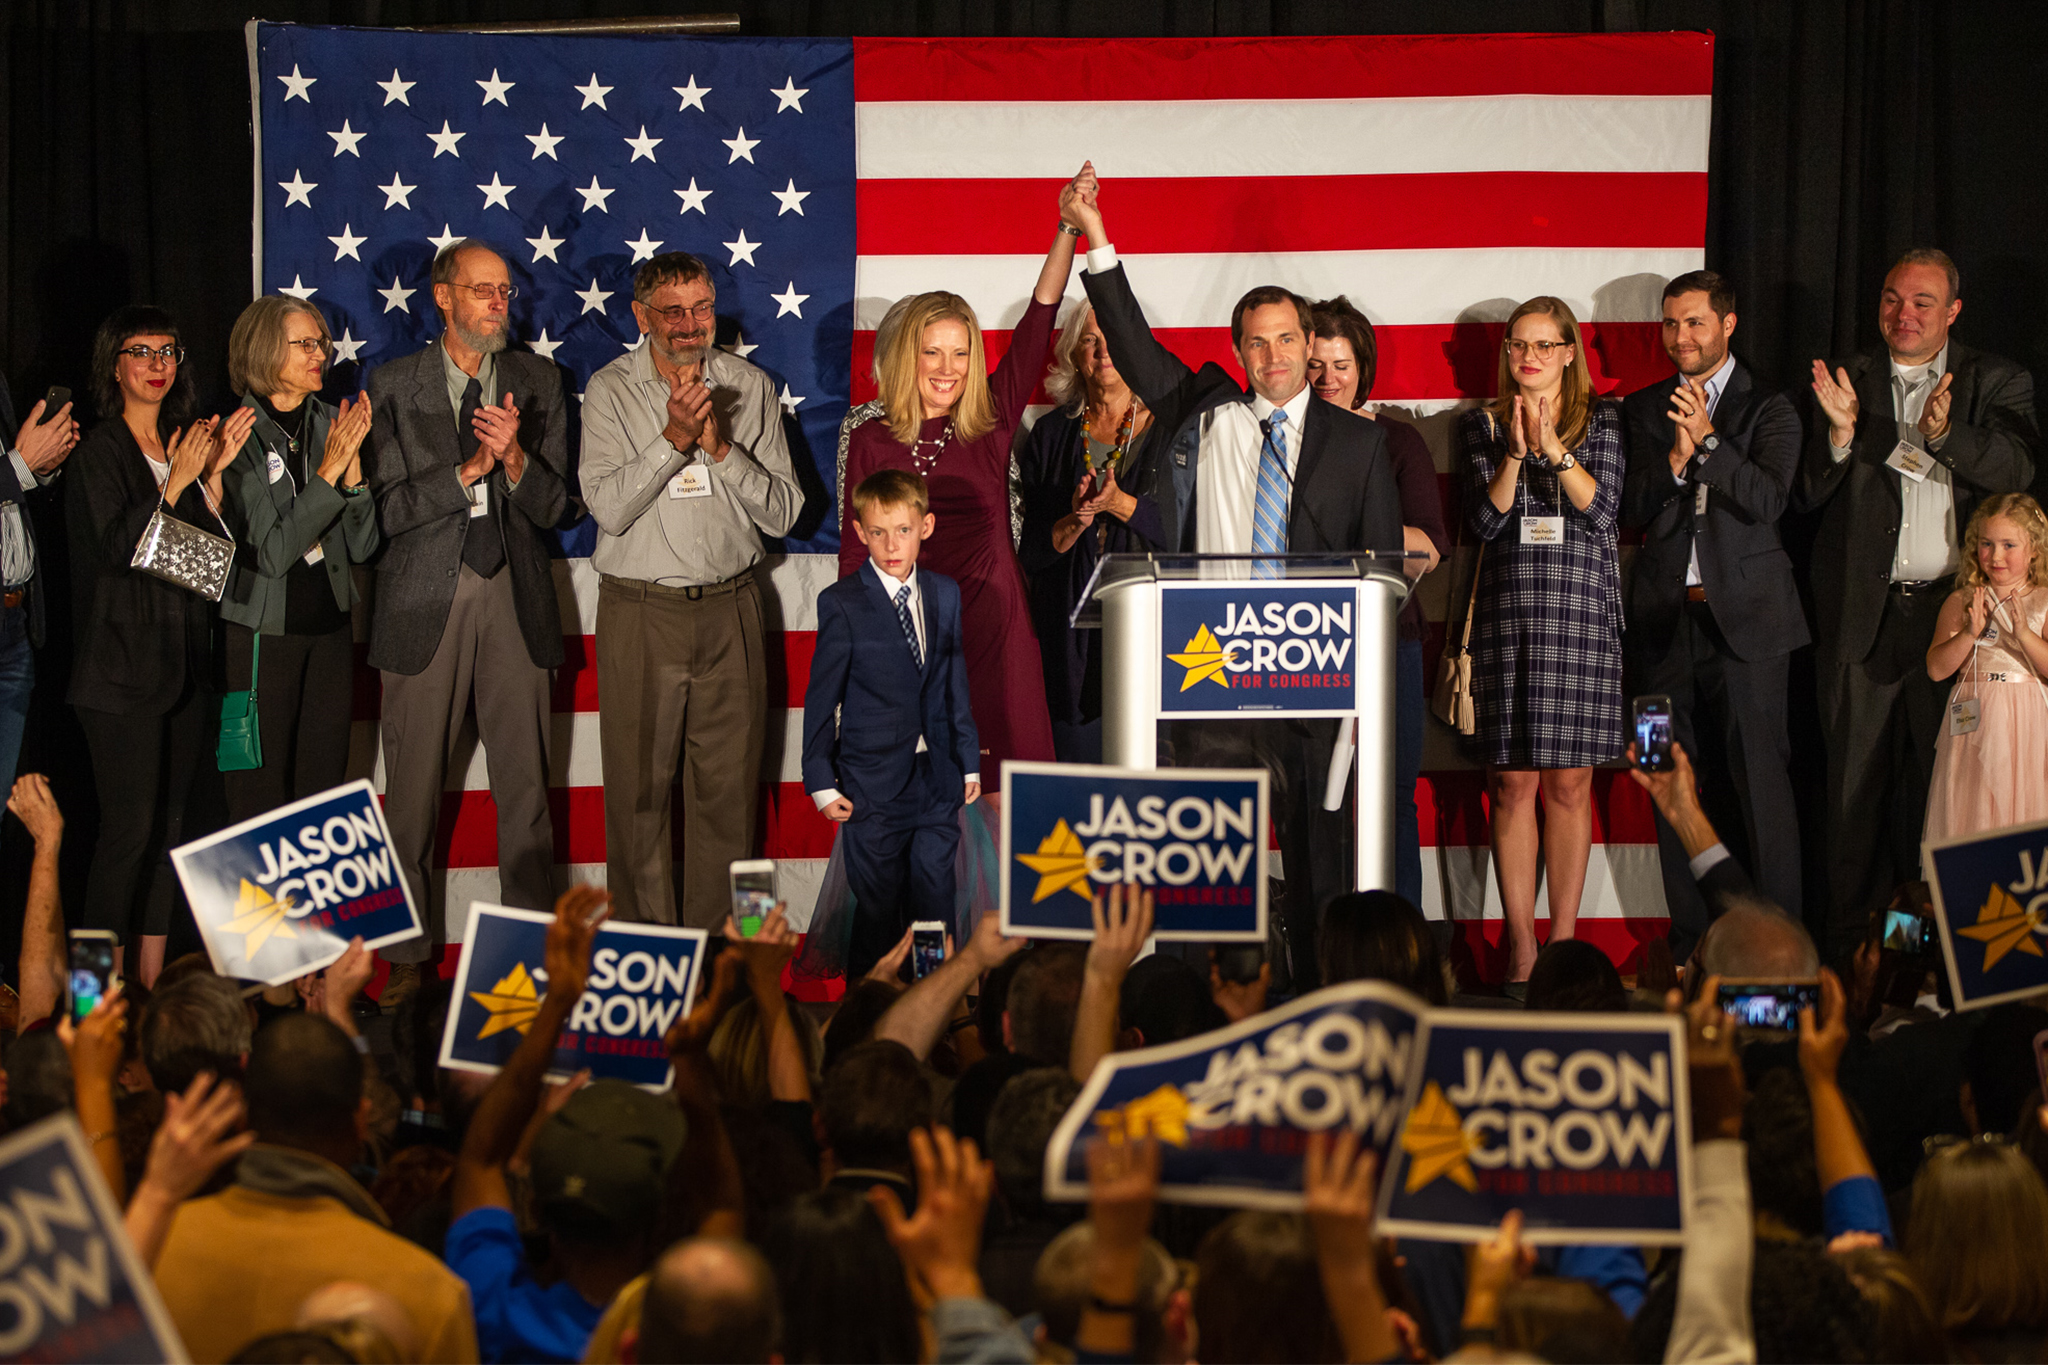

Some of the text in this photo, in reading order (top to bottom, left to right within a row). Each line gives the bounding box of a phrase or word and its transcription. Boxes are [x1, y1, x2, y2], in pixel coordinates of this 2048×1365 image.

[1900, 463, 1915, 473] Crow
[1901, 454, 1923, 469] Stephen
[677, 485, 706, 493] Fitzgerald
[1213, 602, 1351, 636] JASON
[1222, 638, 1352, 673] CROW
[1232, 673, 1351, 689] FOR CONGRESS
[1074, 793, 1254, 841] JASON
[256, 805, 384, 885] JASON
[1084, 839, 1255, 886] CROW
[276, 847, 392, 919] CROW
[532, 947, 691, 995] SON
[537, 991, 682, 1039] ROW
[1183, 1013, 1412, 1101] JASON
[1446, 1047, 1672, 1110] JASON
[1188, 1068, 1403, 1147] CROW
[1461, 1108, 1673, 1170] CROW
[0, 1233, 111, 1357] OW
